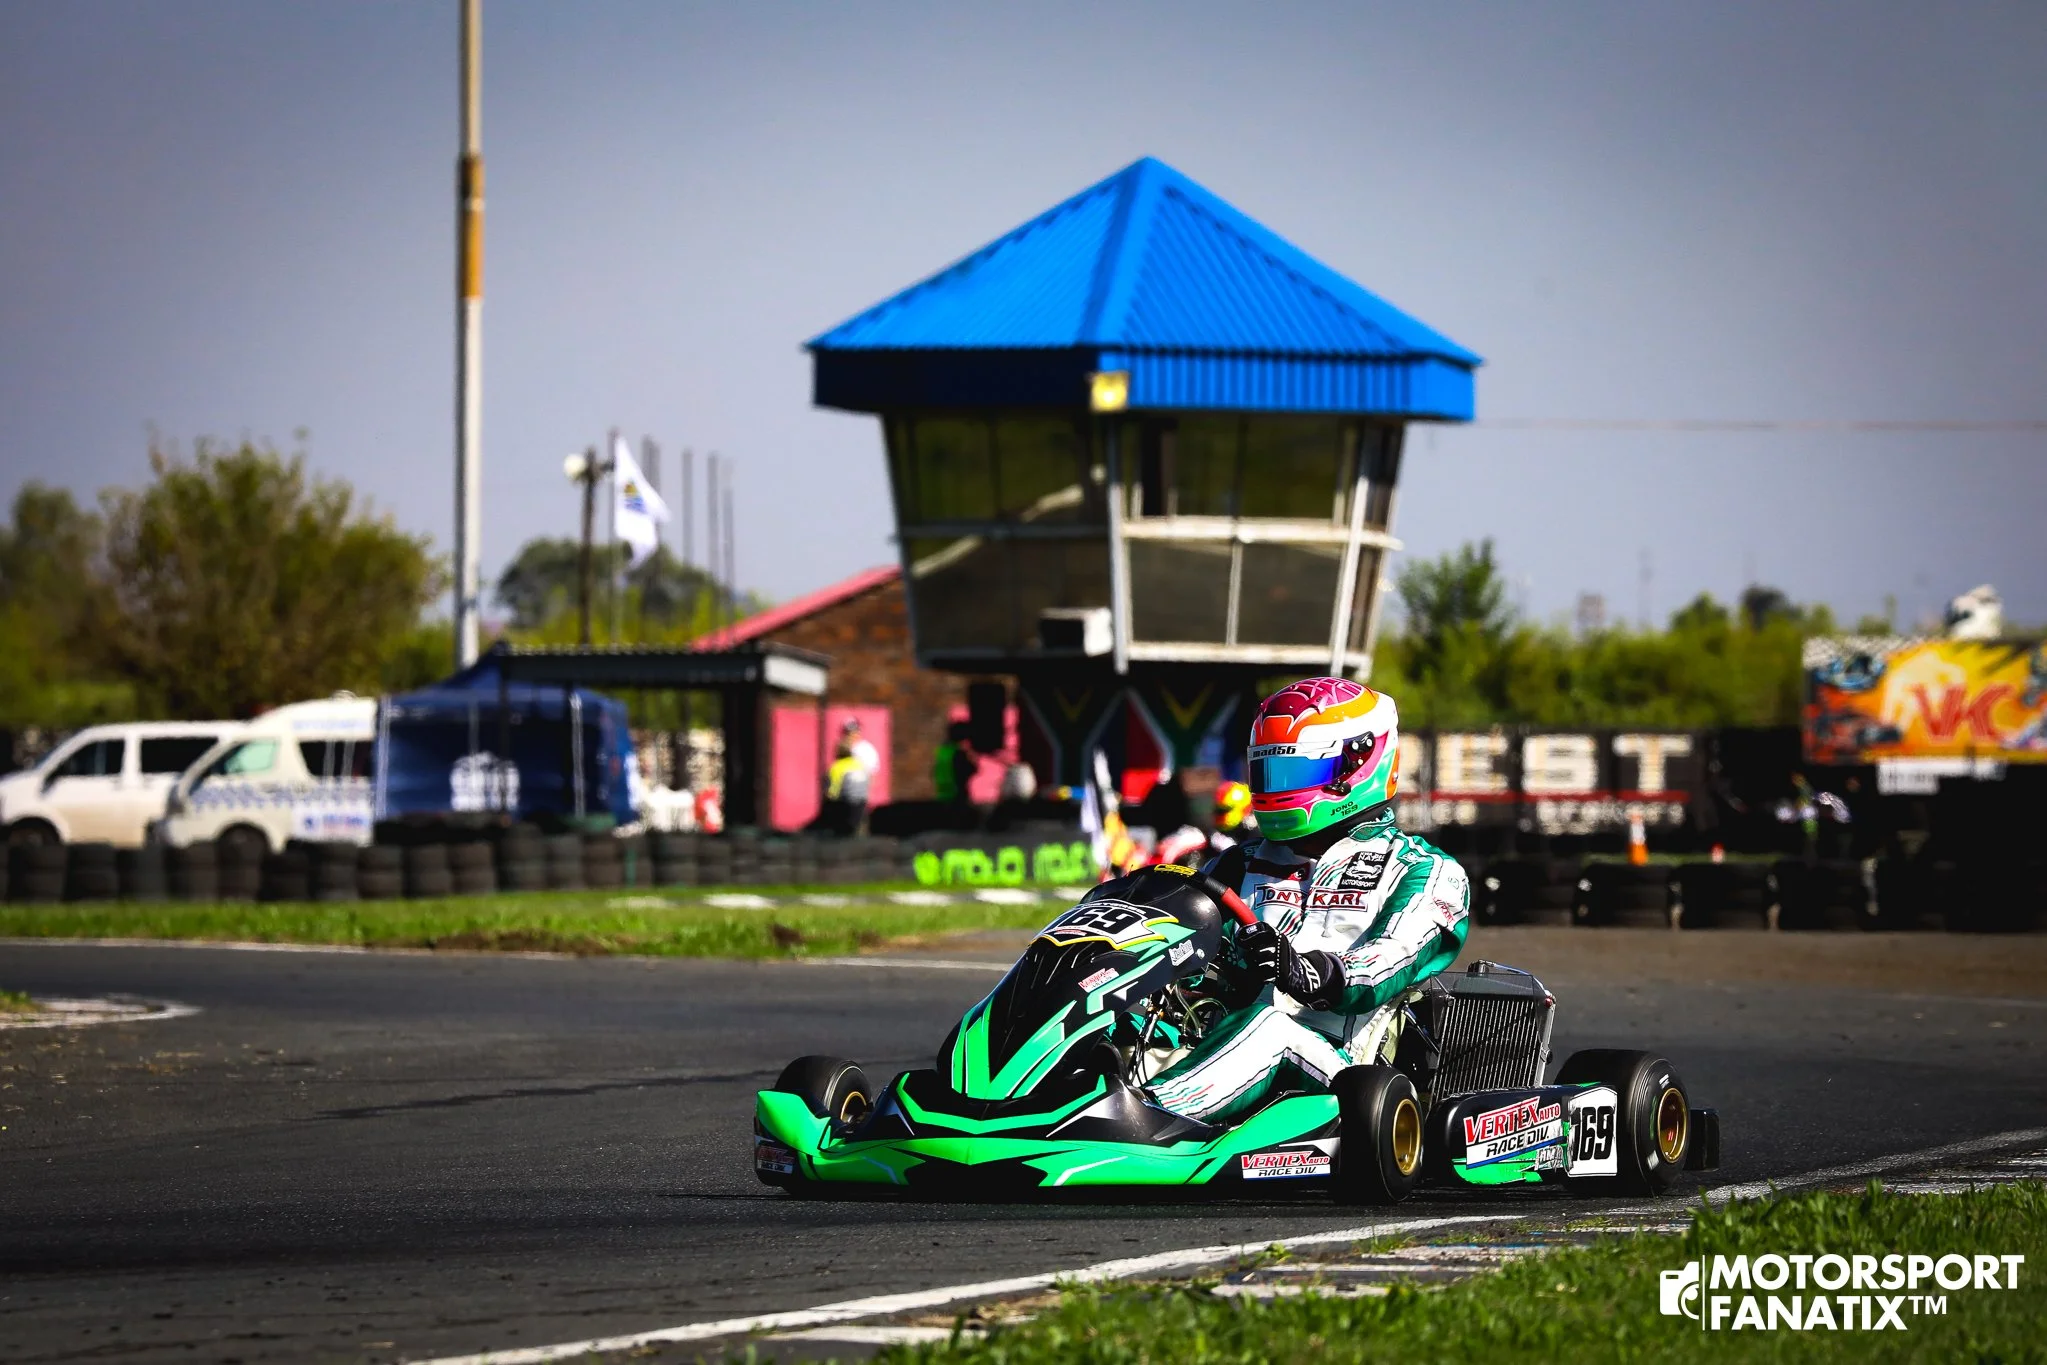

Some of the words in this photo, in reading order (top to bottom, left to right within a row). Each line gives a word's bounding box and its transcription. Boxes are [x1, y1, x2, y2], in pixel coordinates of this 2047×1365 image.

[1252, 745, 1297, 758] mad56
[1330, 801, 1354, 816] JONO
[1341, 804, 1358, 817] 169
[1312, 891, 1365, 906] KART
[1463, 1096, 1540, 1145] VERTEX
[1539, 1103, 1561, 1121] AUTO
[1570, 1105, 1616, 1162] 169
[1486, 1134, 1525, 1158] RACE
[1241, 1151, 1314, 1169] VERTEX
[1308, 1156, 1331, 1164] AUTO
[1258, 1168, 1292, 1177] RACE
